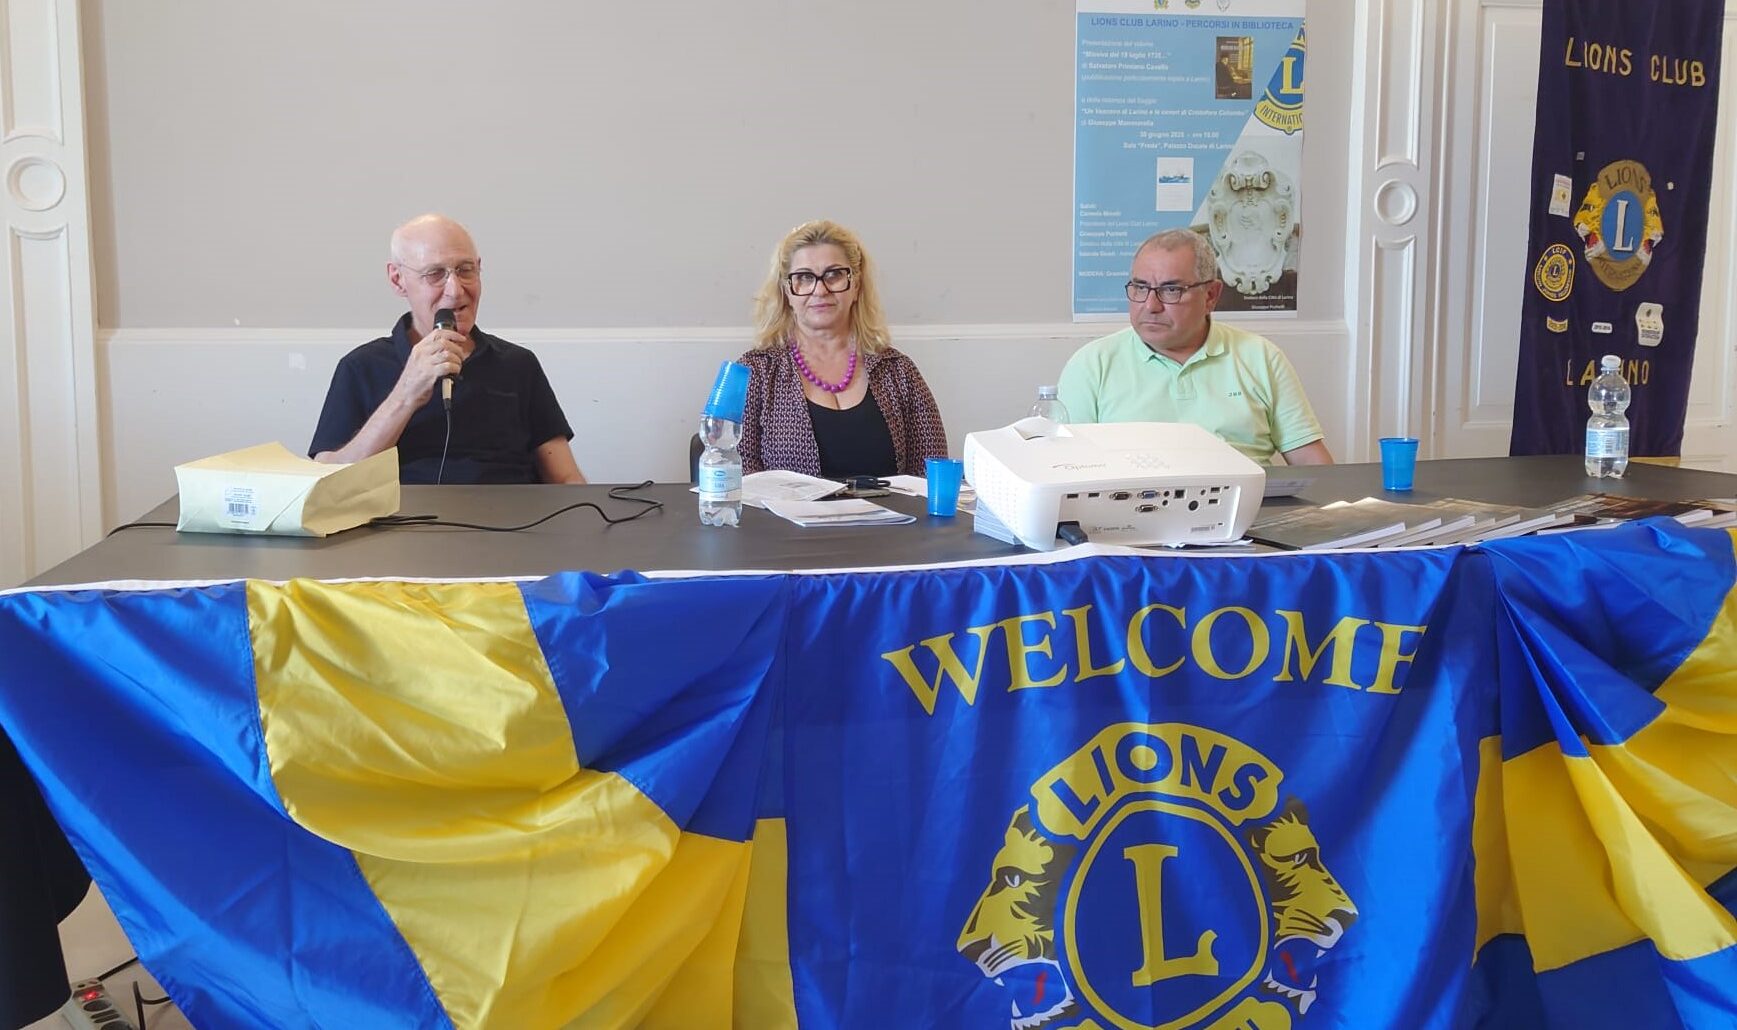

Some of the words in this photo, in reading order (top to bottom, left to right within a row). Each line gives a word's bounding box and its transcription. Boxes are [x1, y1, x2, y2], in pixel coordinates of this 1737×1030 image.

[1090, 17, 1118, 26] LIONS
[1119, 18, 1144, 27] CLUB
[1146, 19, 1179, 28] LARINO
[1185, 19, 1230, 29] PERCORSI
[1231, 21, 1240, 29] IN
[1242, 21, 1294, 30] BIBLIOTECA
[1564, 37, 1633, 76] LIONS
[1650, 54, 1706, 87] CLUB
[1604, 166, 1647, 193] LIONS
[1612, 199, 1634, 251] L
[1566, 359, 1650, 386] LAINO
[882, 603, 1428, 716] WELCOME
[1050, 731, 1268, 826] LIONS
[1124, 843, 1220, 987] L
